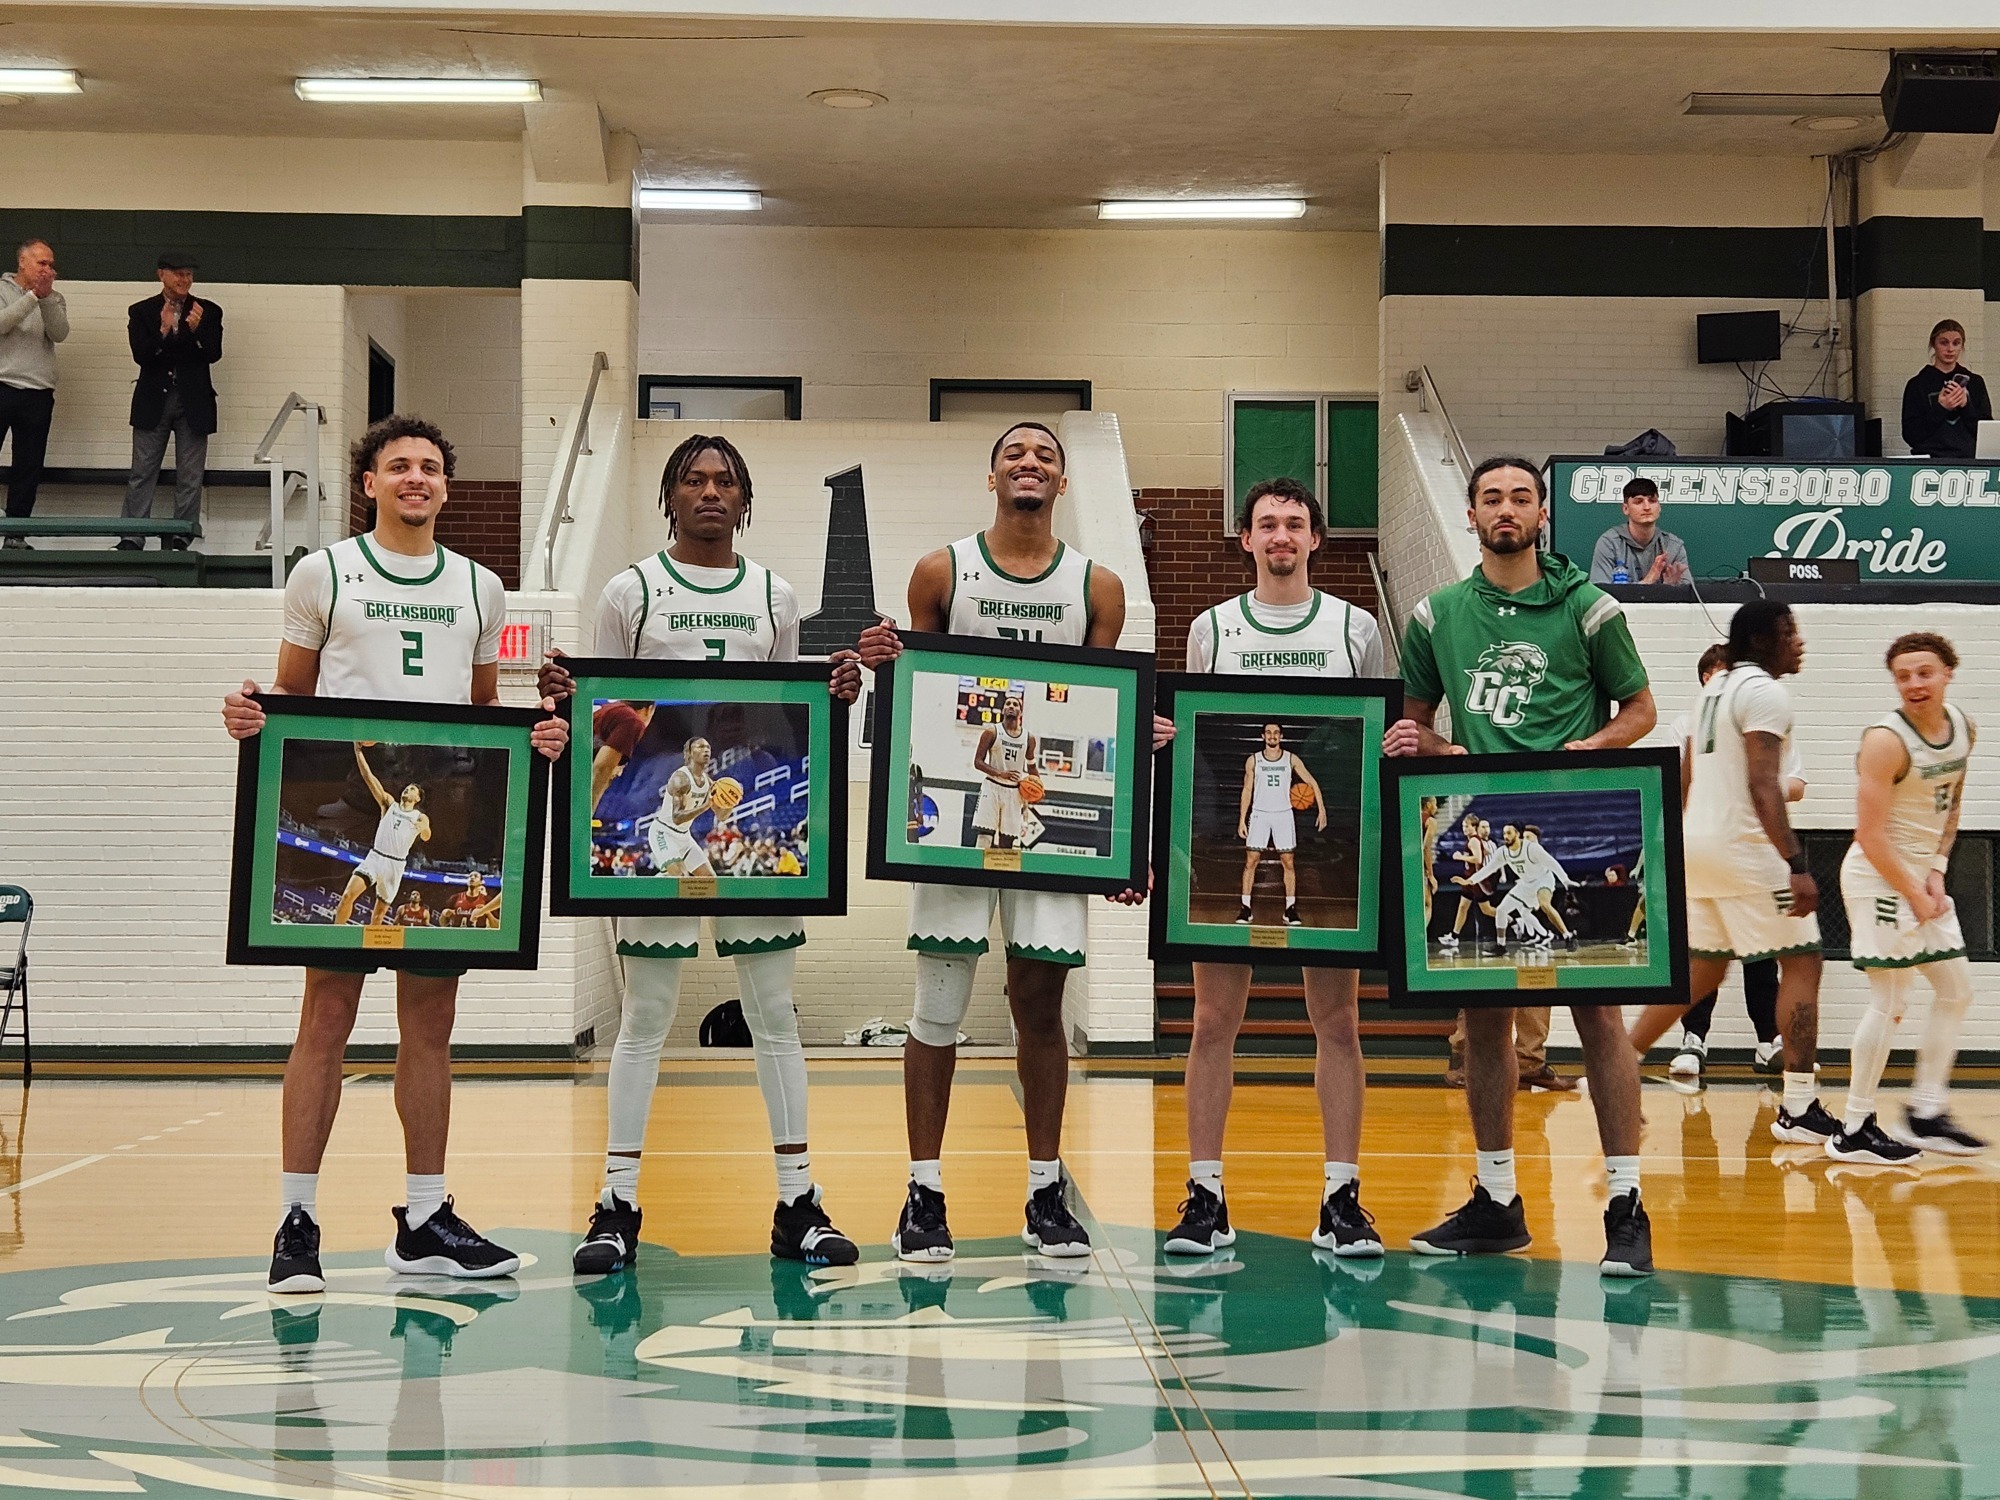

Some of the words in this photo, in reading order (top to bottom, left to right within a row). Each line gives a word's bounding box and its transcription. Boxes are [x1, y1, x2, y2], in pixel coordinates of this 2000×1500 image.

[1569, 466, 1893, 507] GREENSBORO
[1764, 507, 1948, 574] Pride
[1789, 564, 1823, 580] POSS.
[360, 600, 460, 627] GREENSBORO
[664, 612, 759, 634] GREENSBORO
[973, 598, 1066, 623] GREENSBORO
[400, 630, 424, 676] 2
[497, 624, 532, 660] XIT
[1237, 650, 1329, 670] GREENSBORO
[1464, 669, 1530, 727] GC
[1004, 748, 1018, 761] 24
[1267, 774, 1280, 787] 25
